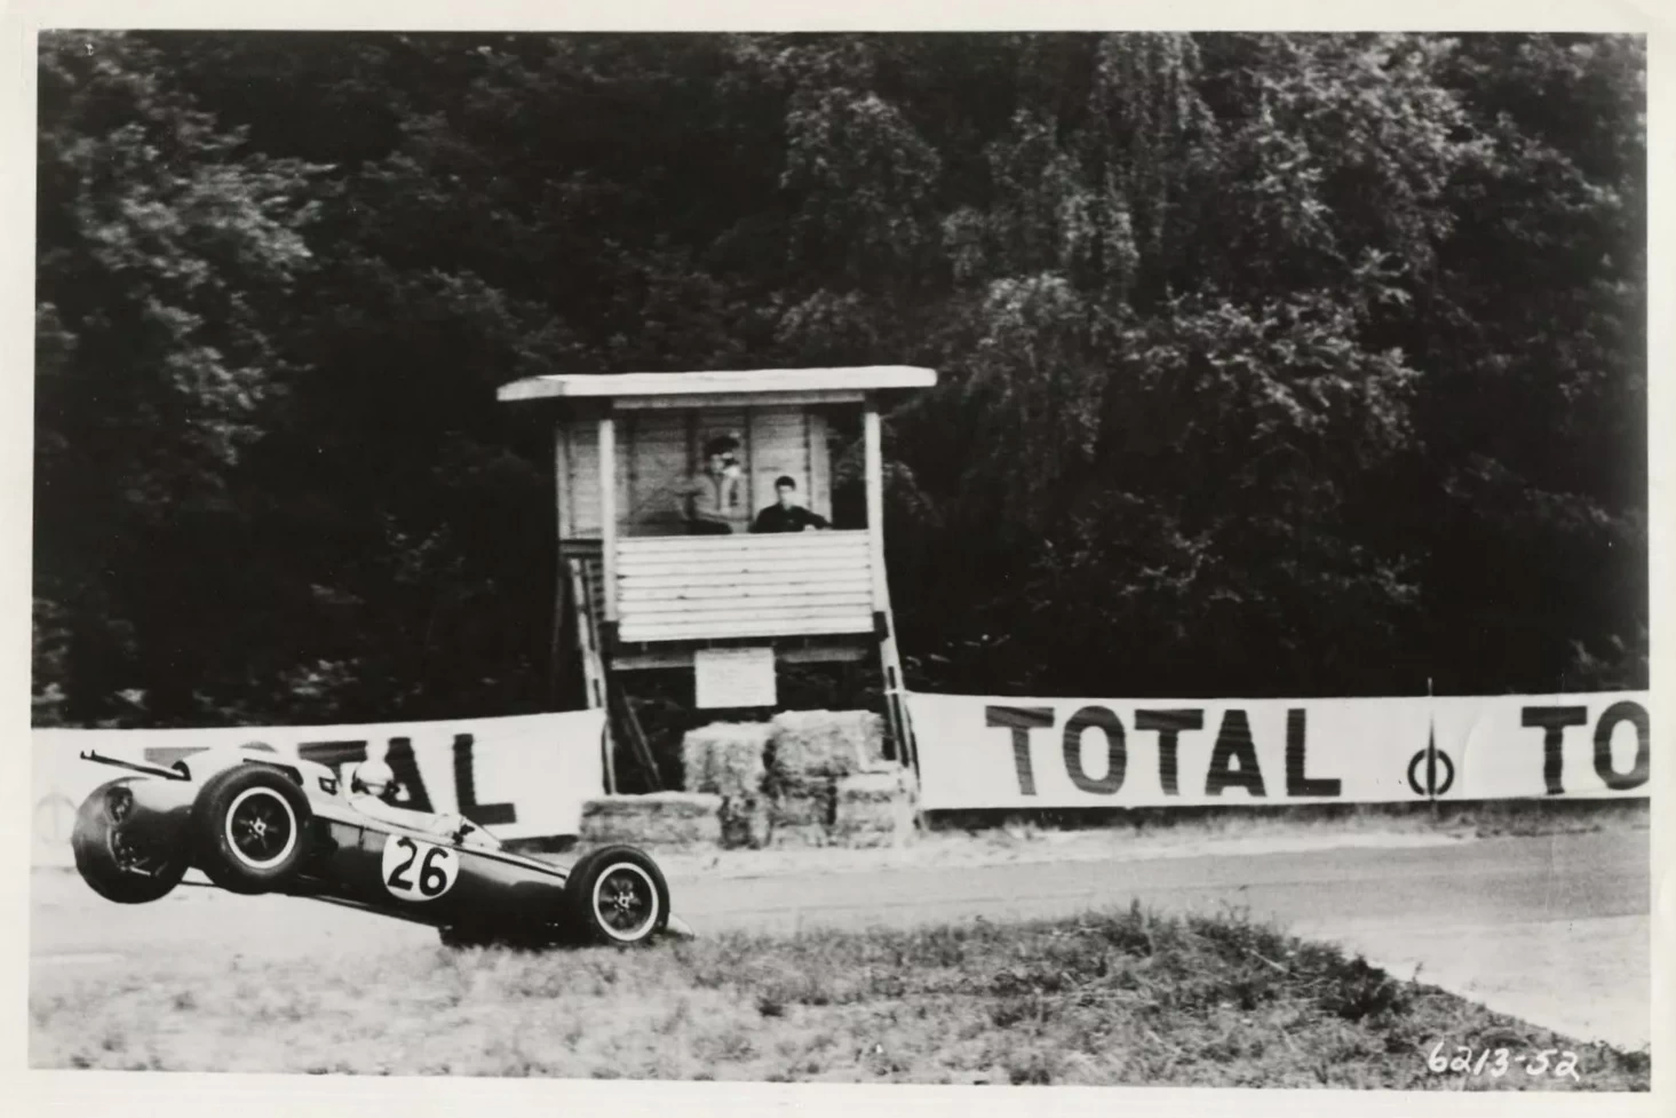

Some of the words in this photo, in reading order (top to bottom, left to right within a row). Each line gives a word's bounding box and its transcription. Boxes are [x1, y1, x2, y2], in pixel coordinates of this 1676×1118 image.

[985, 705, 1342, 798] TOTAL
[1520, 700, 1650, 795] TO
[387, 836, 449, 897] 26
